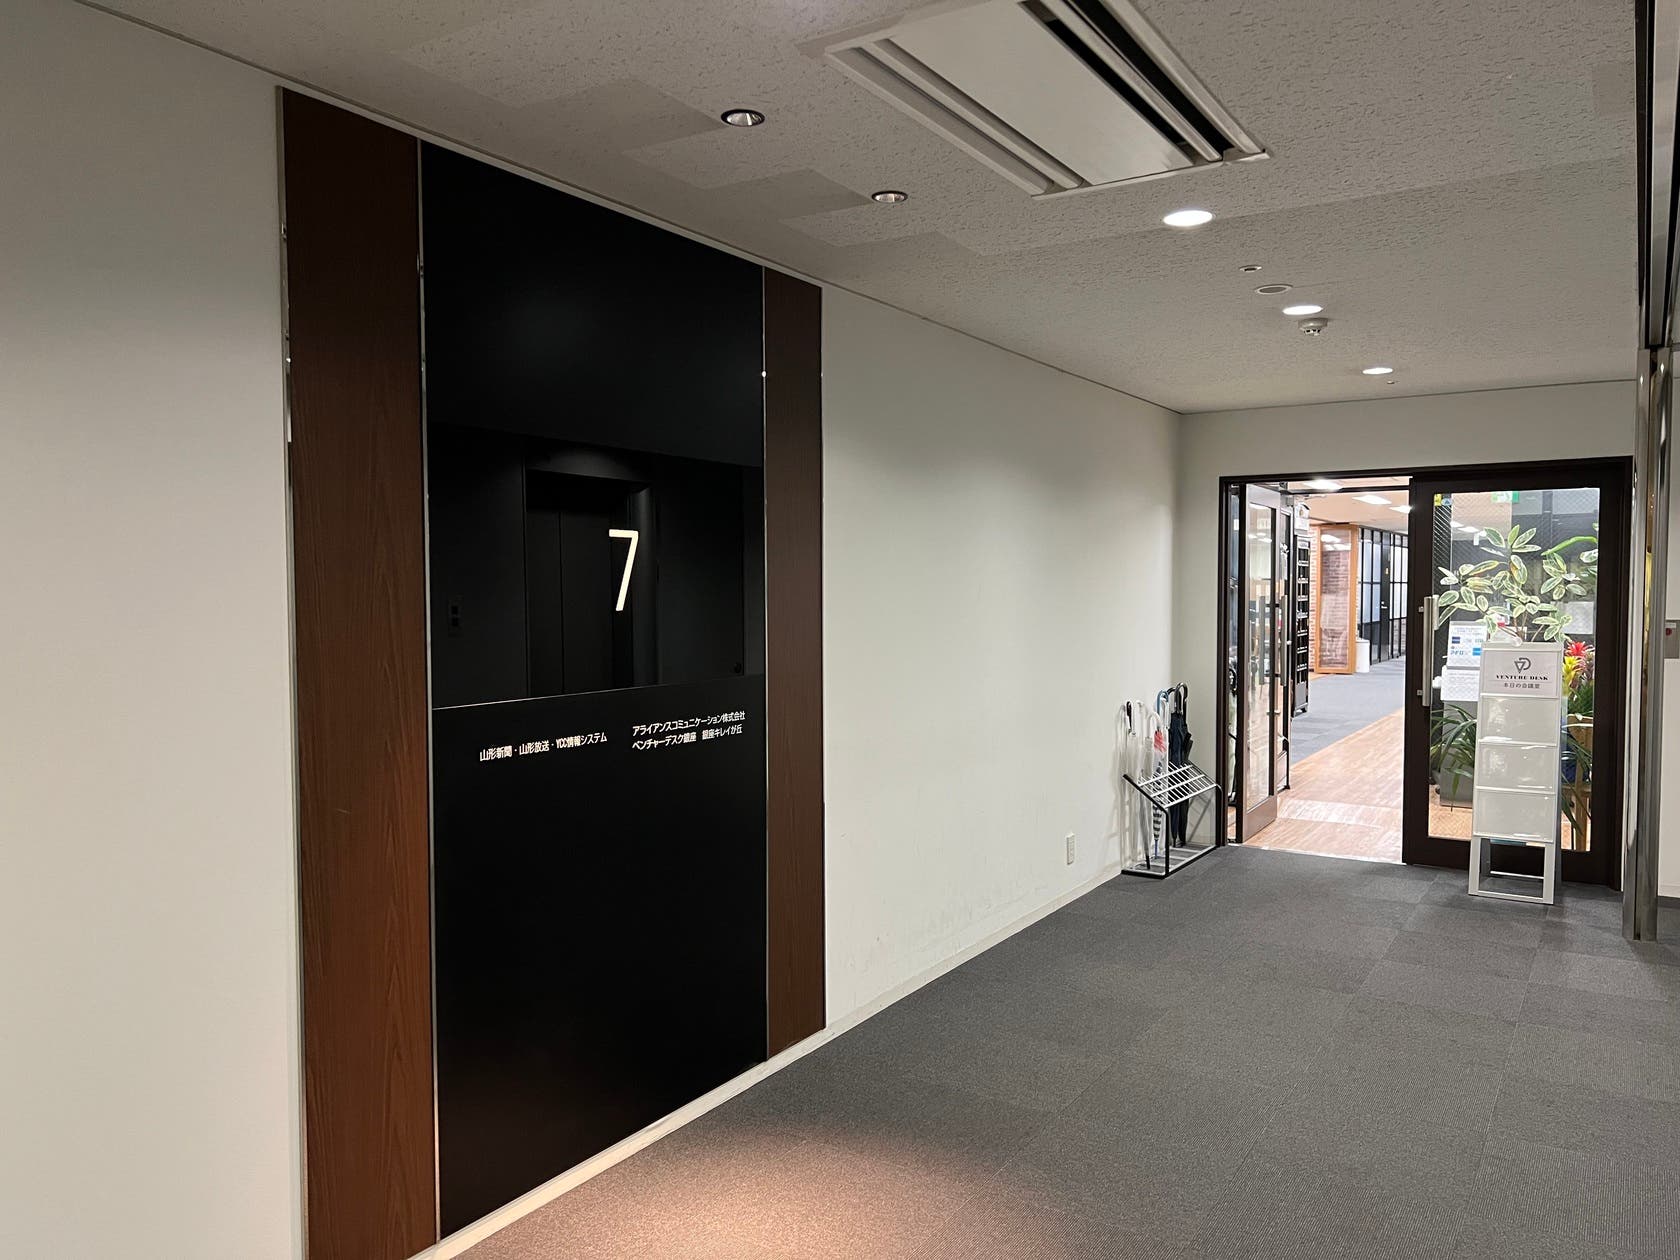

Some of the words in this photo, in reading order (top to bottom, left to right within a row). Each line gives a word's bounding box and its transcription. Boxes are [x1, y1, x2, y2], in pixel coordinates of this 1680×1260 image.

[608, 529, 639, 612] 7
[632, 710, 746, 737] アライアンスコミュニケーション株式会社
